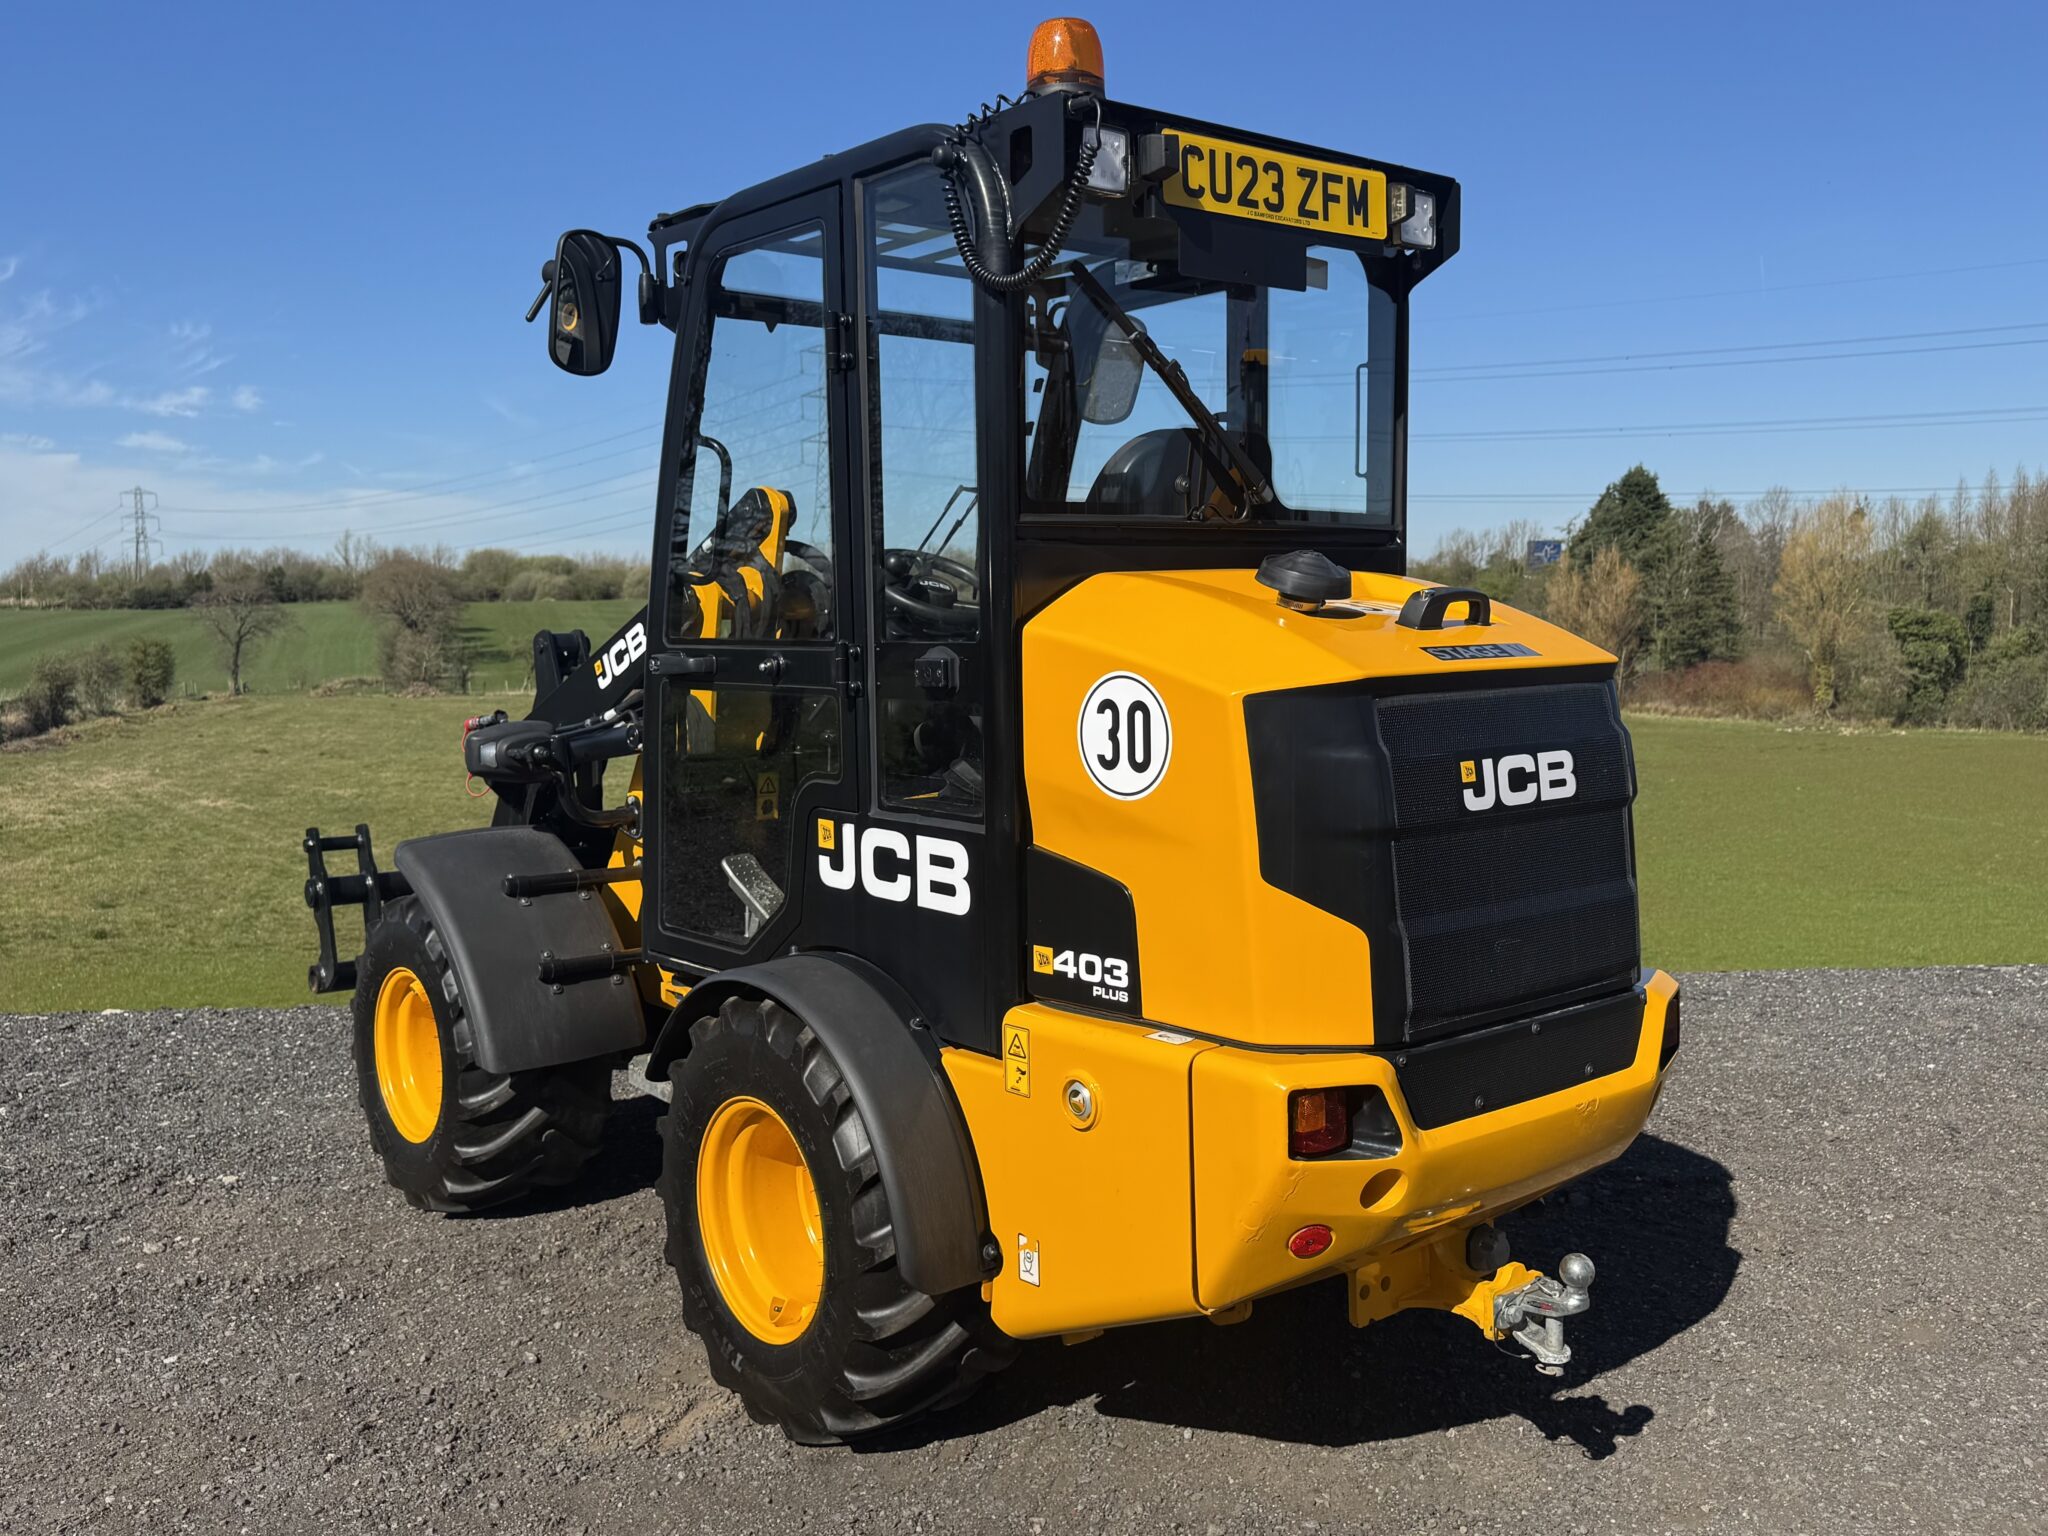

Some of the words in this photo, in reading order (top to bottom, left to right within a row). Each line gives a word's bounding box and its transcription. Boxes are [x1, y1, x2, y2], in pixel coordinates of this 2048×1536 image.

[1181, 144, 1285, 213] CU23
[1296, 167, 1369, 228] ZFM
[597, 622, 647, 690] JCB
[1426, 645, 1510, 660] STAGE
[1096, 698, 1152, 774] 30
[1463, 750, 1577, 811] JCB
[818, 822, 971, 916] JCB
[1053, 949, 1129, 988] 403
[1092, 985, 1129, 1003] PLUS
